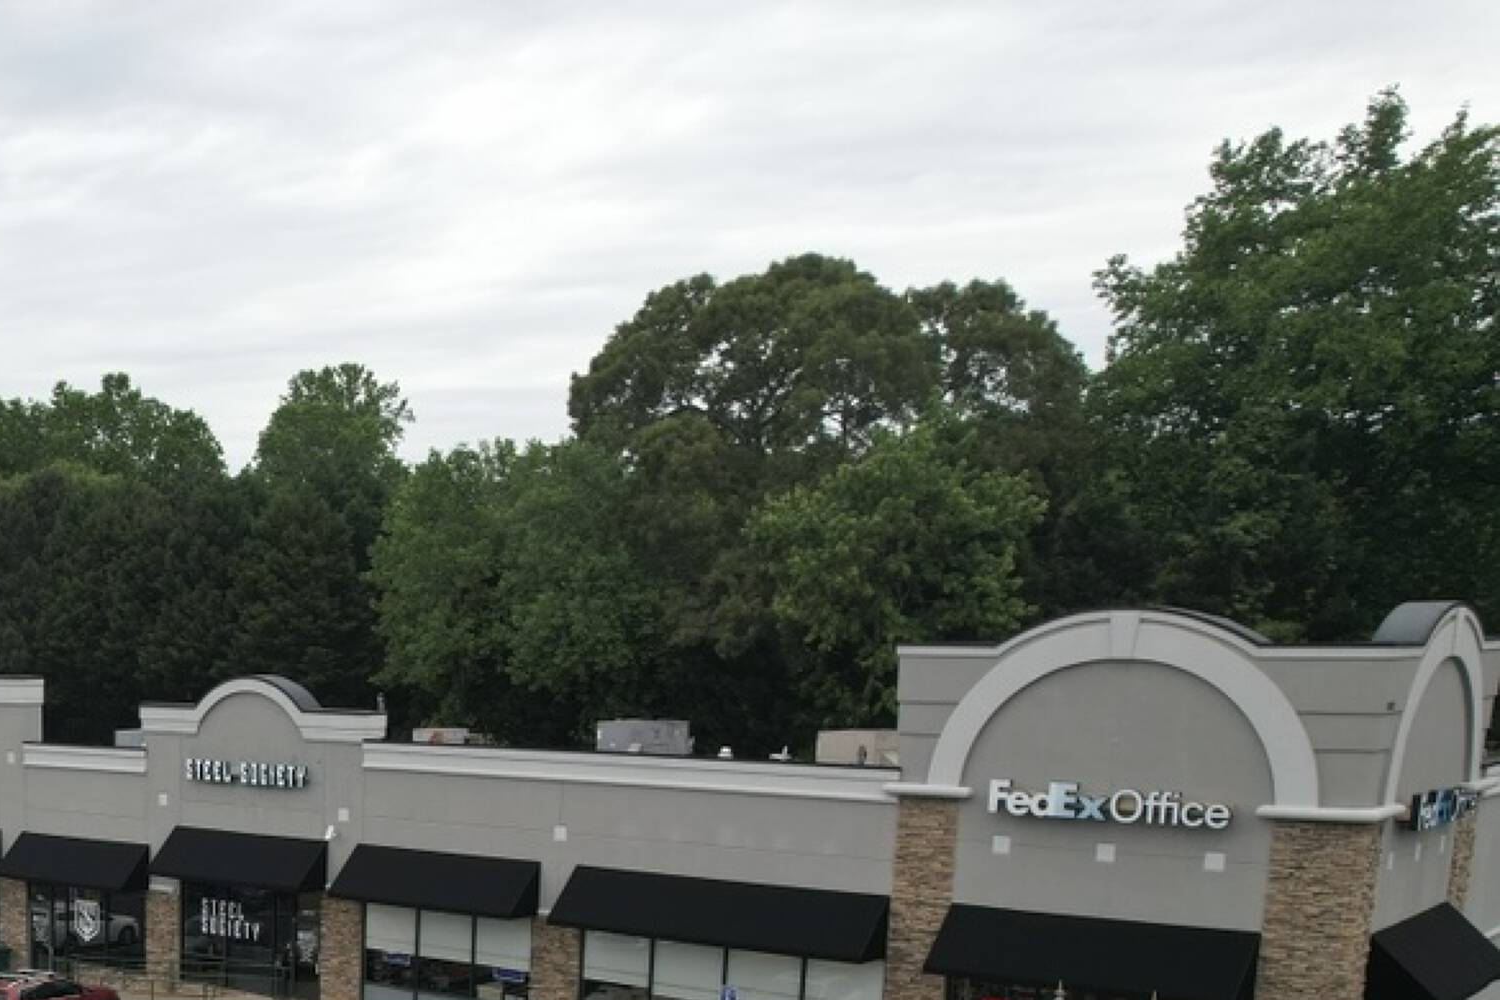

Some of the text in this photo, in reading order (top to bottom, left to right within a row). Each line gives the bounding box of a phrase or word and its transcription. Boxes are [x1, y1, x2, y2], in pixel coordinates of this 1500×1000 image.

[186, 758, 232, 784] STEEL
[987, 778, 1233, 830] FedEx Office
